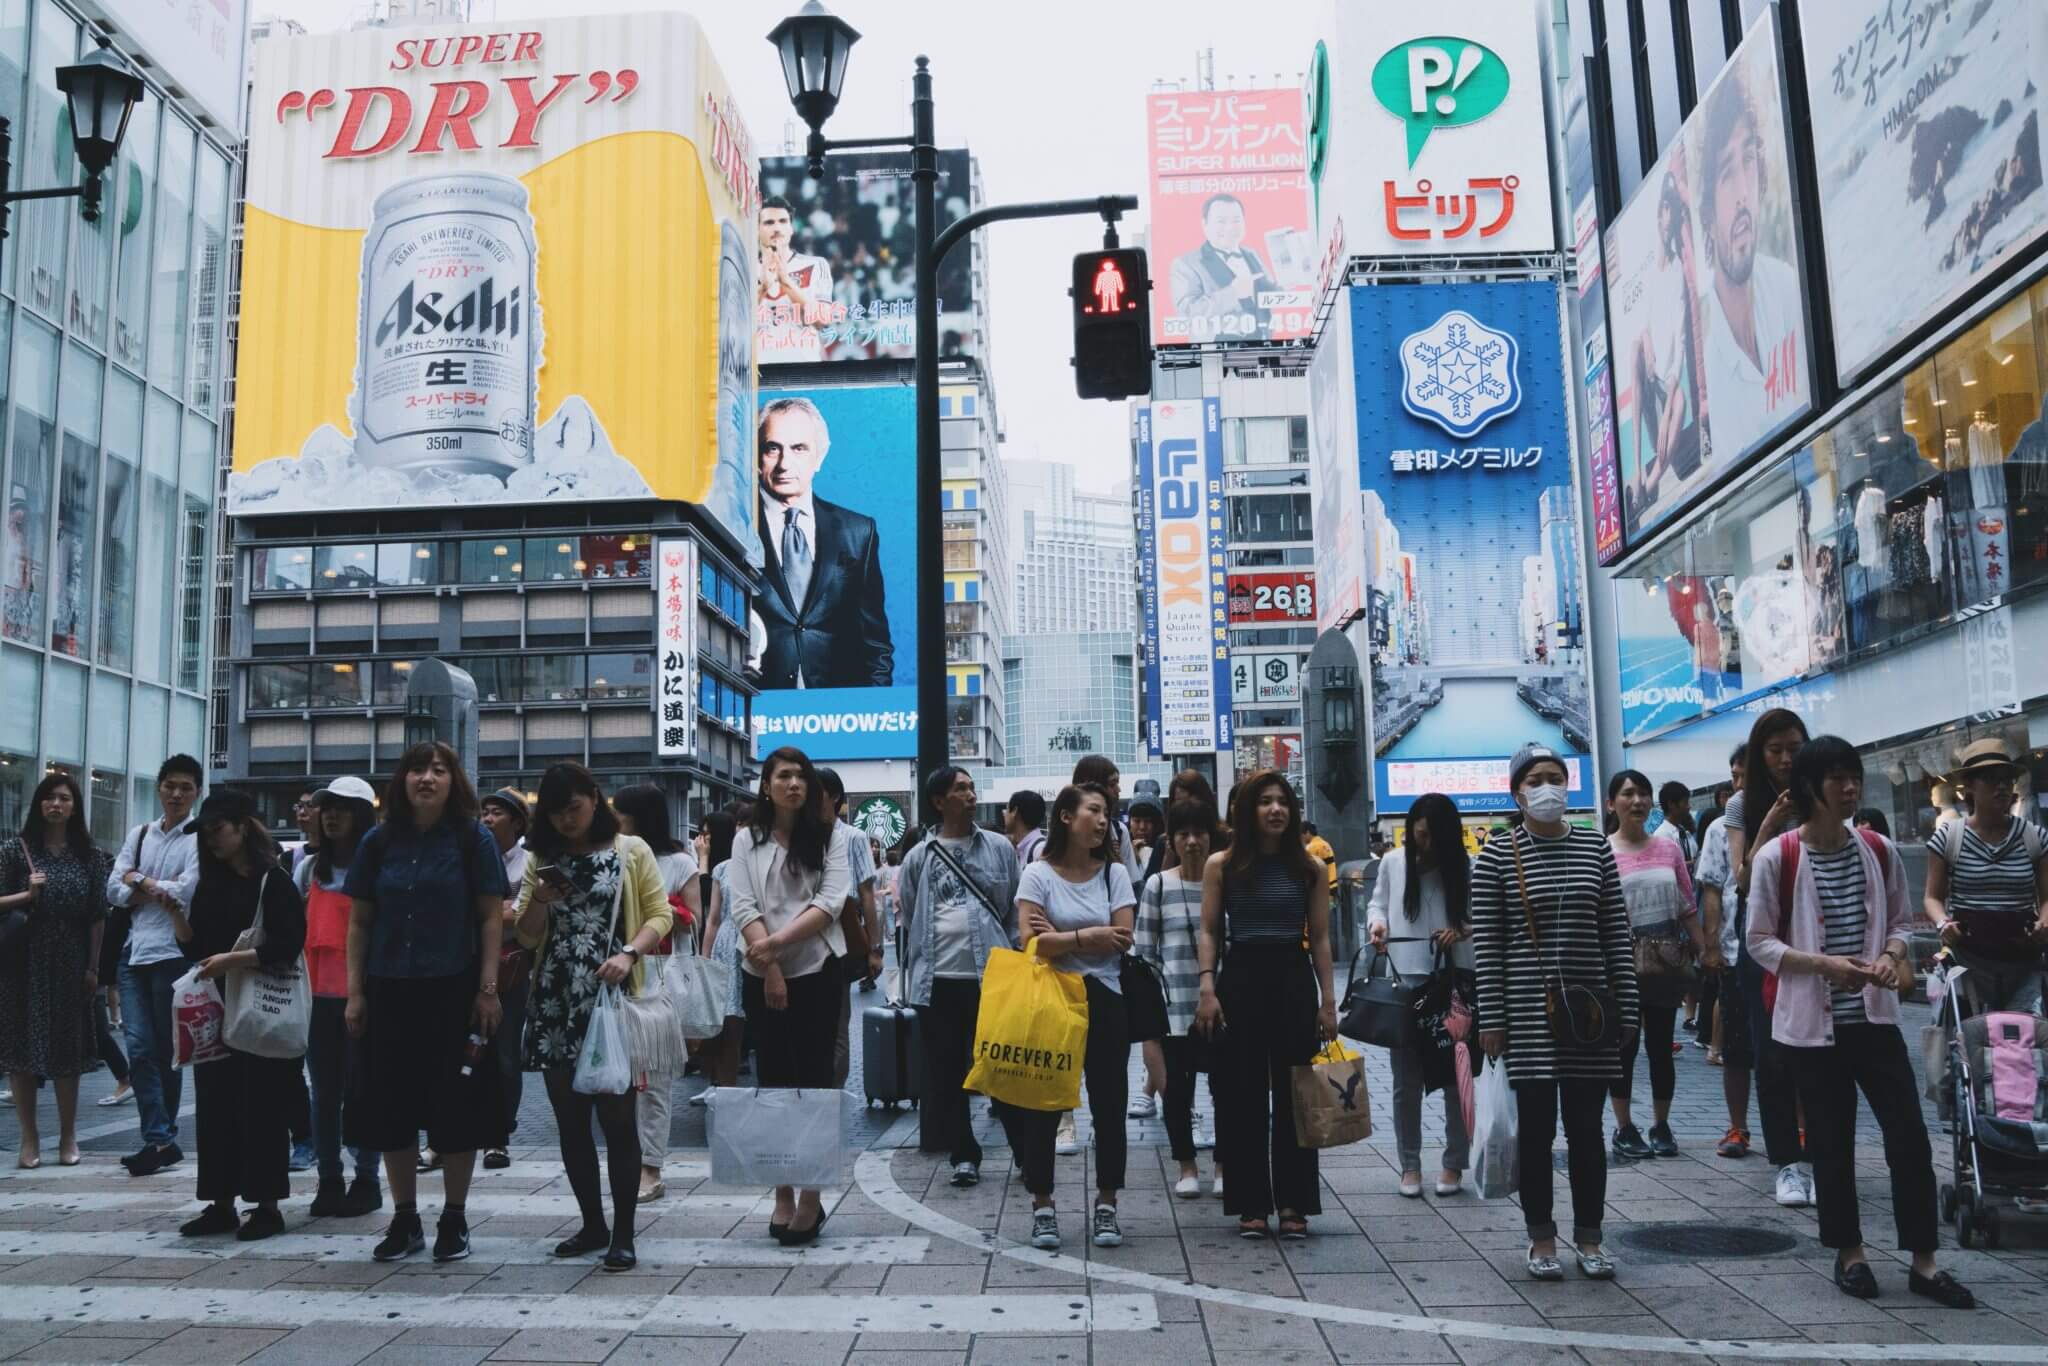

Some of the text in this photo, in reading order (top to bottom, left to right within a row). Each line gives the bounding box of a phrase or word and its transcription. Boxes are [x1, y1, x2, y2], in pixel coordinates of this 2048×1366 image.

[389, 31, 545, 71] SUPER
[1156, 95, 1266, 124] スーパー
[1157, 154, 1223, 171] SUPER
[1384, 175, 1519, 239] ピップ
[420, 227, 474, 245] BREWERIES
[375, 276, 520, 348] Asahi
[425, 358, 468, 386] 生
[405, 391, 490, 409] スーパードライ
[426, 436, 463, 450] 350ml
[1389, 446, 1543, 471] 雪印メグミルク
[1166, 612, 1201, 624] Japan
[1166, 622, 1201, 633] Quality
[1166, 635, 1203, 643] Store
[261, 1004, 281, 1015] SAD
[262, 994, 293, 1007] ANGRY
[980, 1041, 1072, 1071] FOREVER 21
